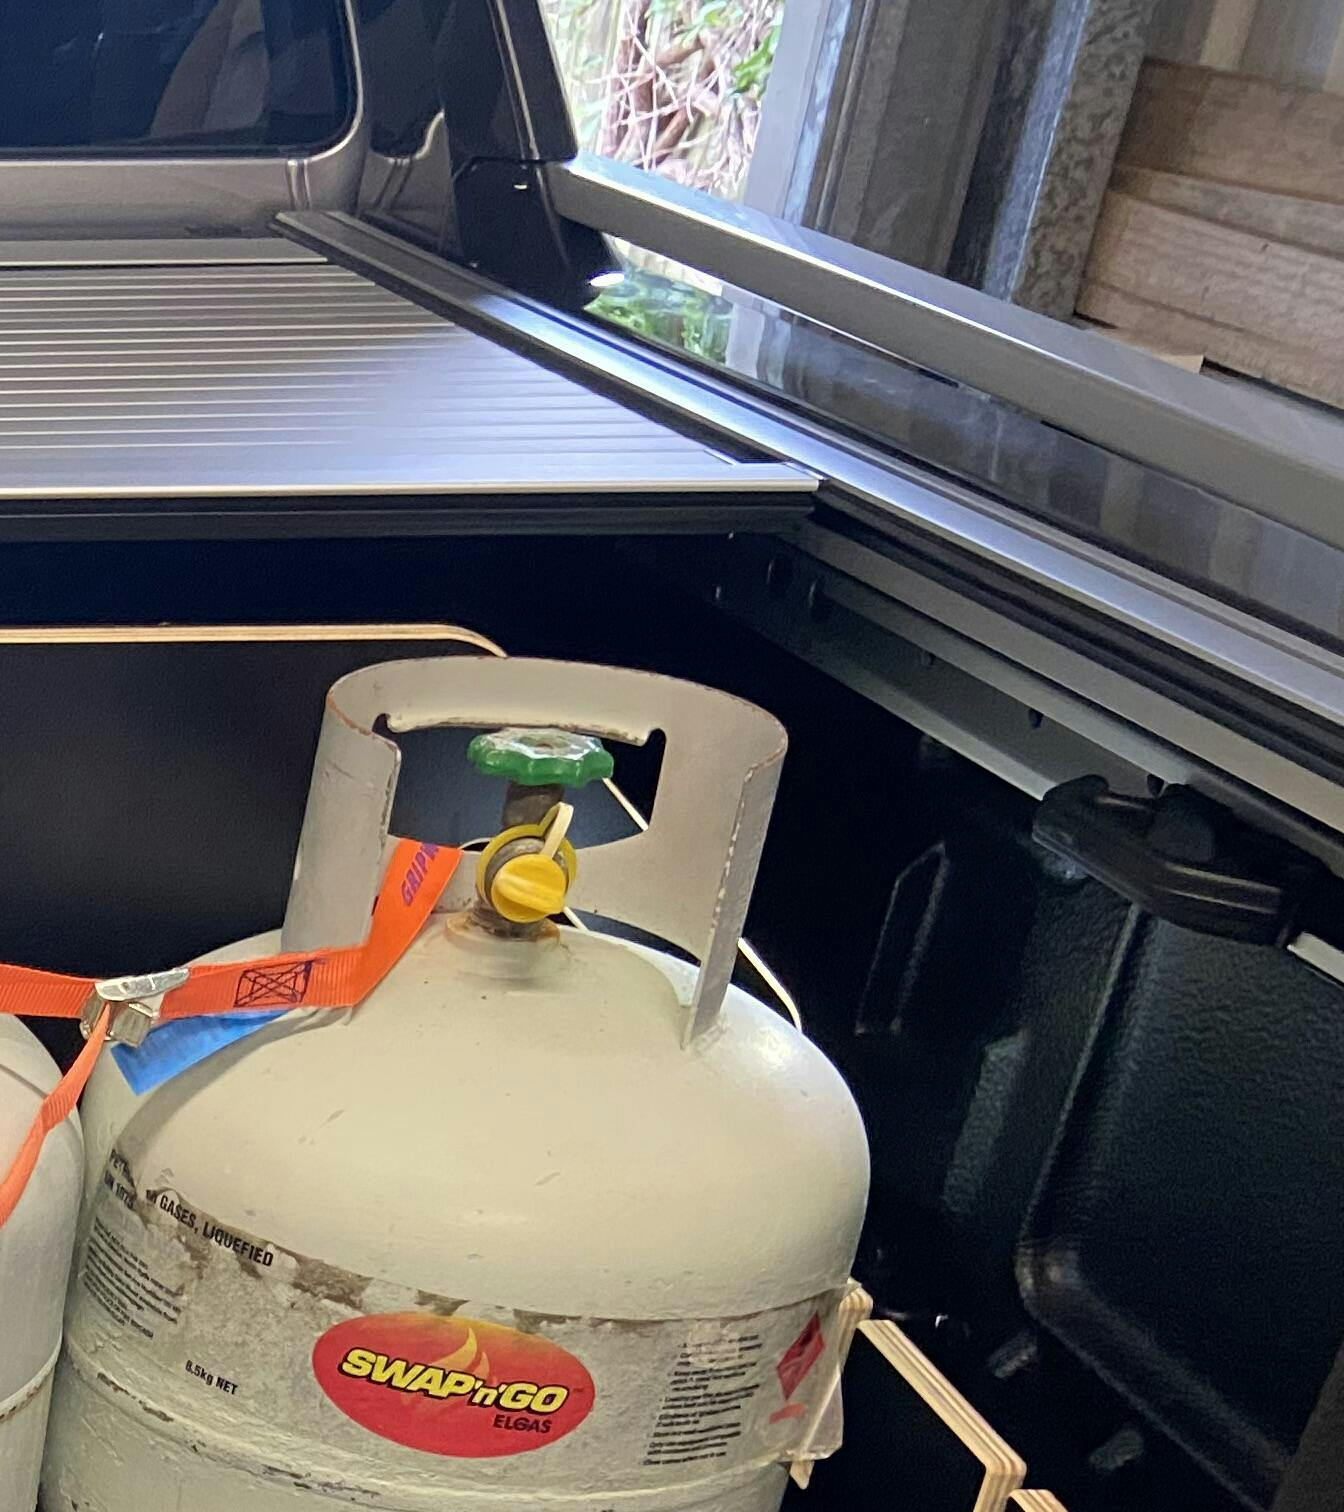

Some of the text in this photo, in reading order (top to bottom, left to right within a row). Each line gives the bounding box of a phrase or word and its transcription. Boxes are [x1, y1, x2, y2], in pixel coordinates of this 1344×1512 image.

[159, 1195, 199, 1234] GASES,
[202, 1222, 274, 1267] LIQUEFIED
[215, 1375, 239, 1396] NET
[493, 1414, 553, 1434] ELGAS
